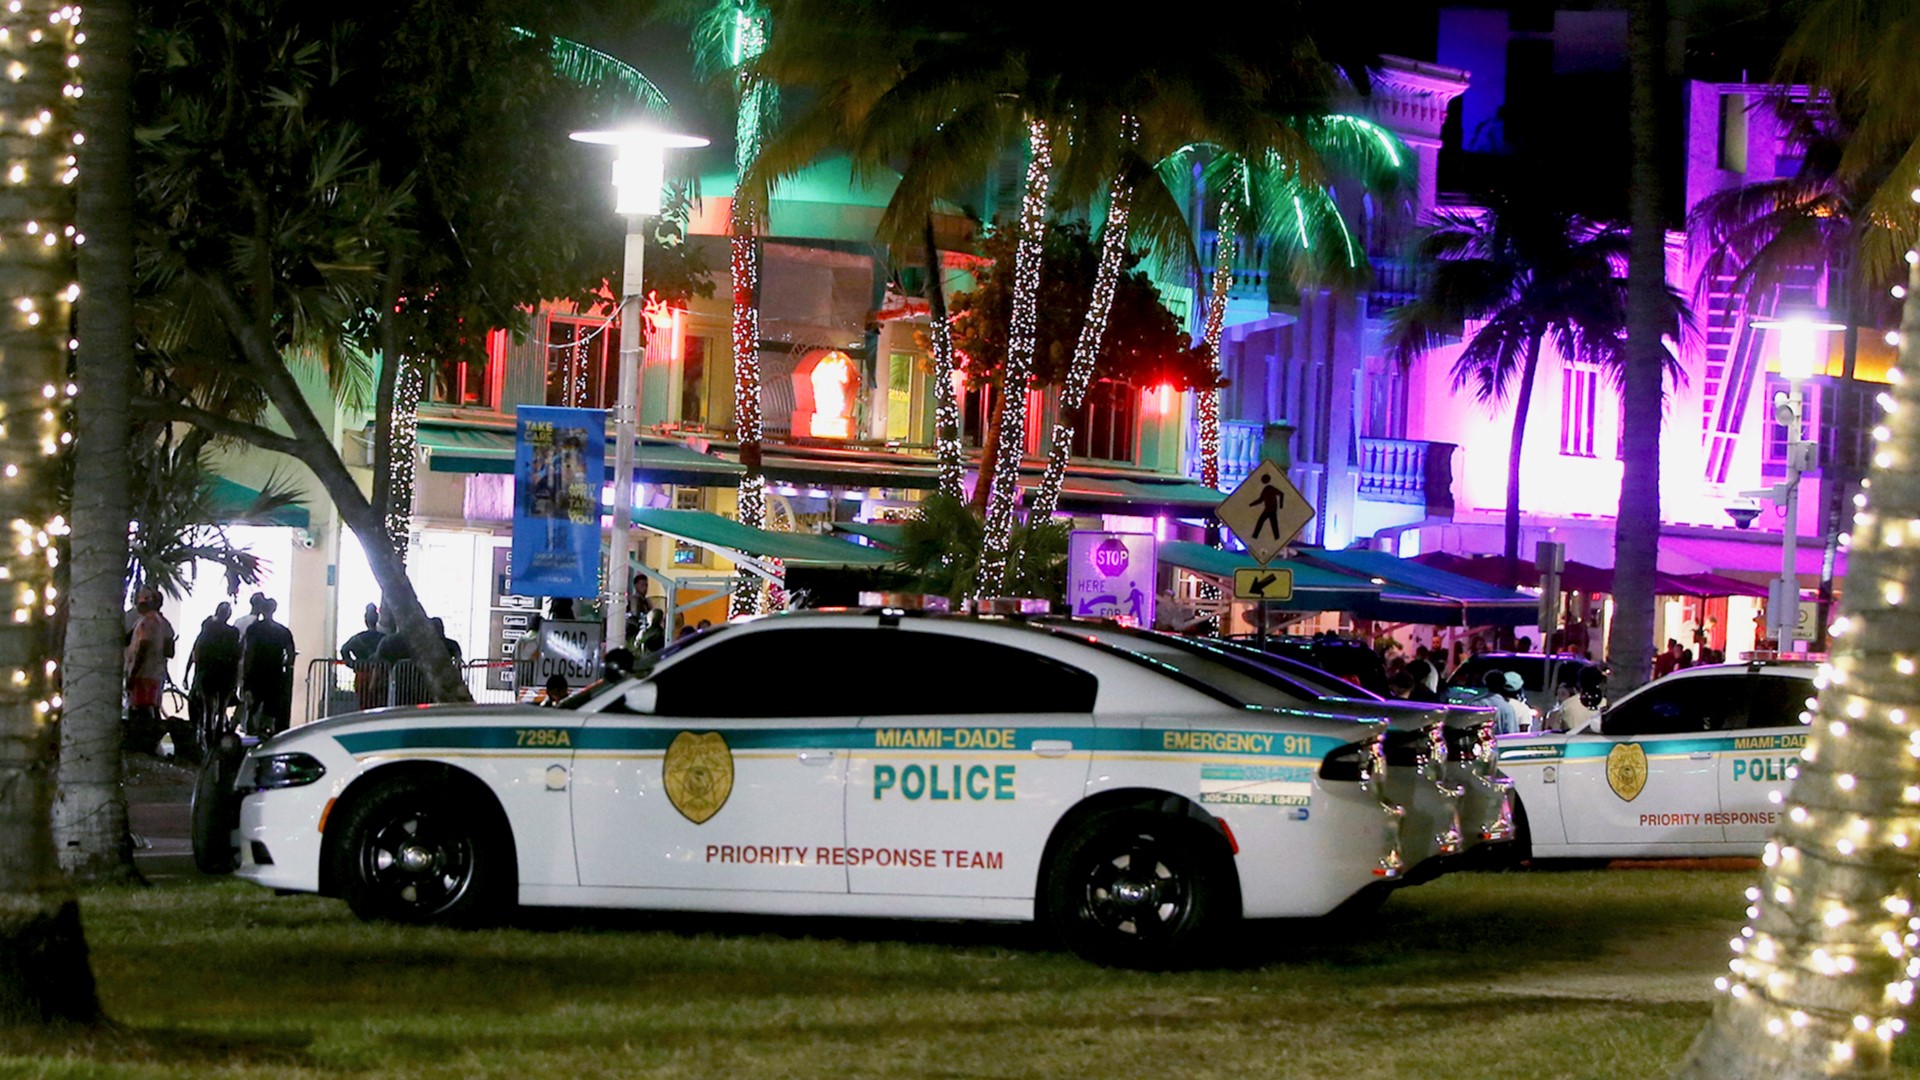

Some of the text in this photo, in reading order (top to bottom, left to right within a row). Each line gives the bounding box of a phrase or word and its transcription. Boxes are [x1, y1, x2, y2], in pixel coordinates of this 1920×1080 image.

[524, 420, 554, 432] TAKE
[523, 431, 554, 441] CARE
[568, 498, 596, 508] TAKE
[568, 514, 594, 525] YOU
[1097, 550, 1129, 566] STOP
[1078, 580, 1106, 593] HERE
[542, 657, 593, 678] CLOSED
[516, 728, 572, 747] 7295A
[875, 728, 1017, 749] MIAMI-DADE
[1162, 731, 1312, 755] EMERGENCY 911
[1735, 735, 1808, 750] MIAMI-DAD
[1733, 757, 1800, 781] POLI
[872, 763, 1017, 801] POLICE
[1639, 813, 1700, 826] PRIORITY
[1704, 811, 1776, 825] RESPONSE
[706, 845, 1004, 870] PRIORITY RESPONSE TEAM
